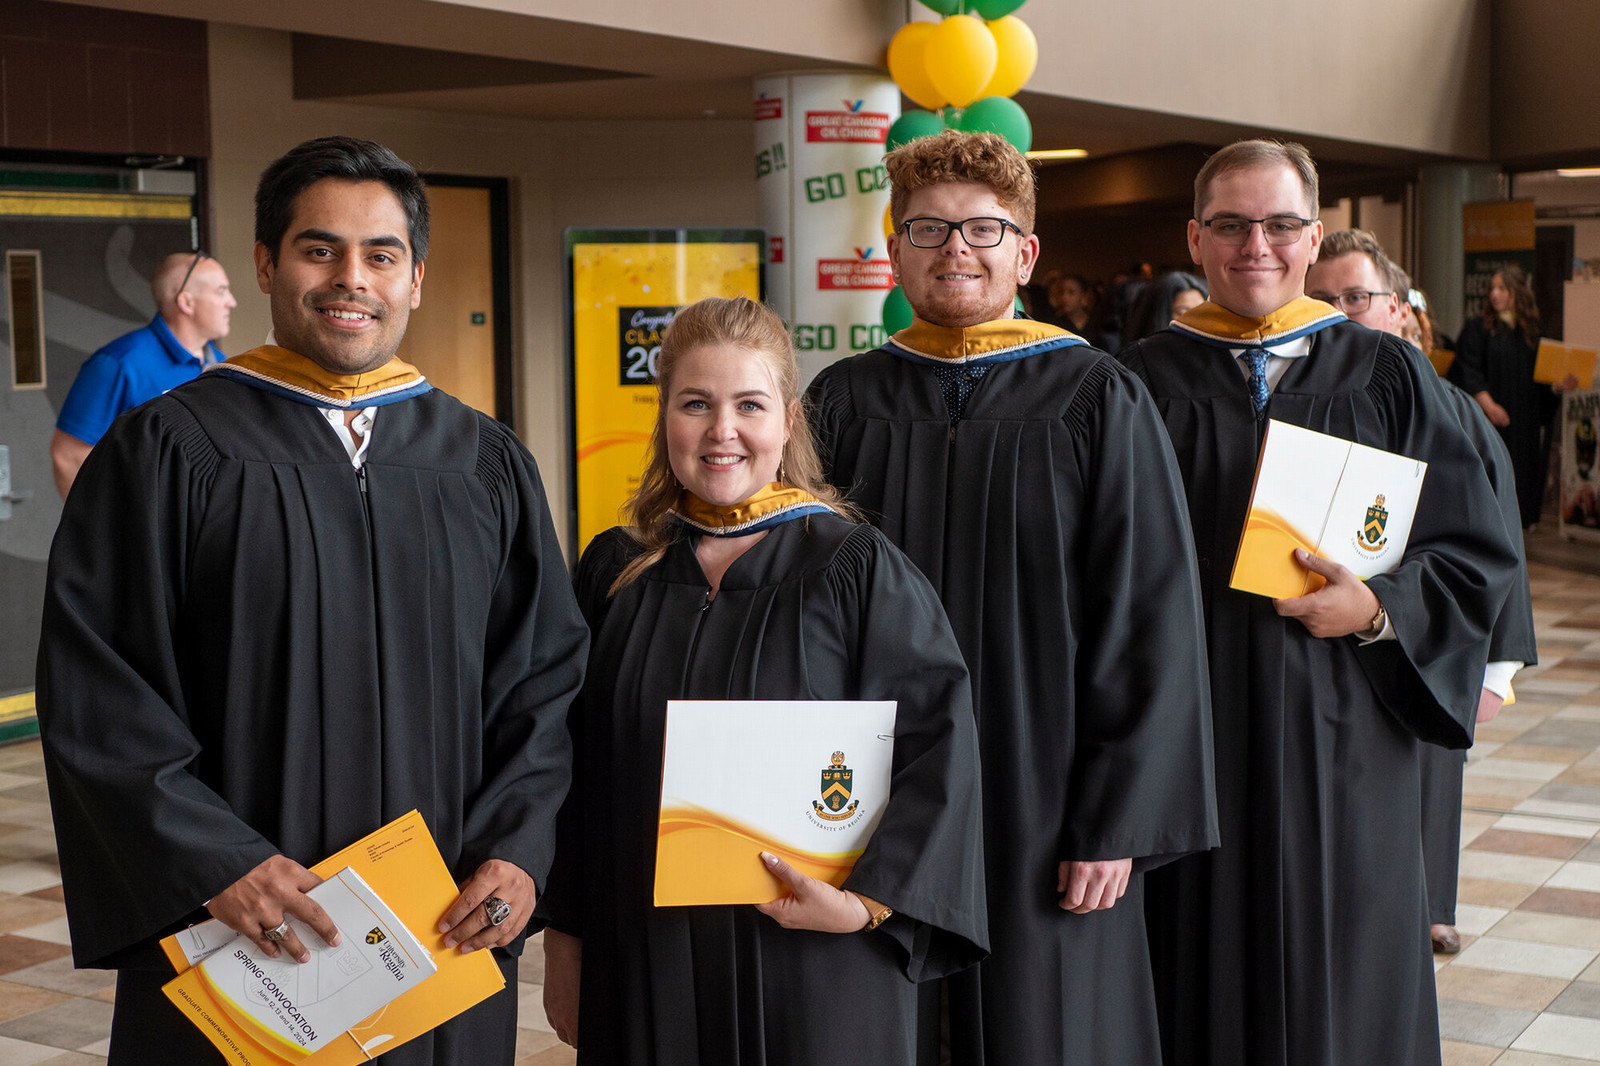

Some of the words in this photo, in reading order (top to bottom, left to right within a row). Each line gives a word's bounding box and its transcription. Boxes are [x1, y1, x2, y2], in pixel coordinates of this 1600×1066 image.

[820, 127, 838, 138] OIL
[840, 127, 881, 138] CHANGE
[805, 173, 846, 203] GO
[856, 165, 889, 194] CO
[832, 275, 849, 286] OIL
[850, 275, 889, 286] CHANGE
[796, 324, 836, 351] GO
[806, 810, 836, 832] UNIVERSITY
[380, 950, 405, 981] Regina
[383, 940, 406, 968] University
[234, 949, 265, 979] SPRING
[261, 977, 318, 1042] CONVOCATION
[177, 988, 202, 1012] GRADUATE
[201, 1011, 240, 1053] COMMEMORATIVE
[237, 1051, 253, 1066] PROG
[257, 989, 270, 1001] June
[280, 1013, 290, 1026] and
[293, 1032, 307, 1046] 2024
